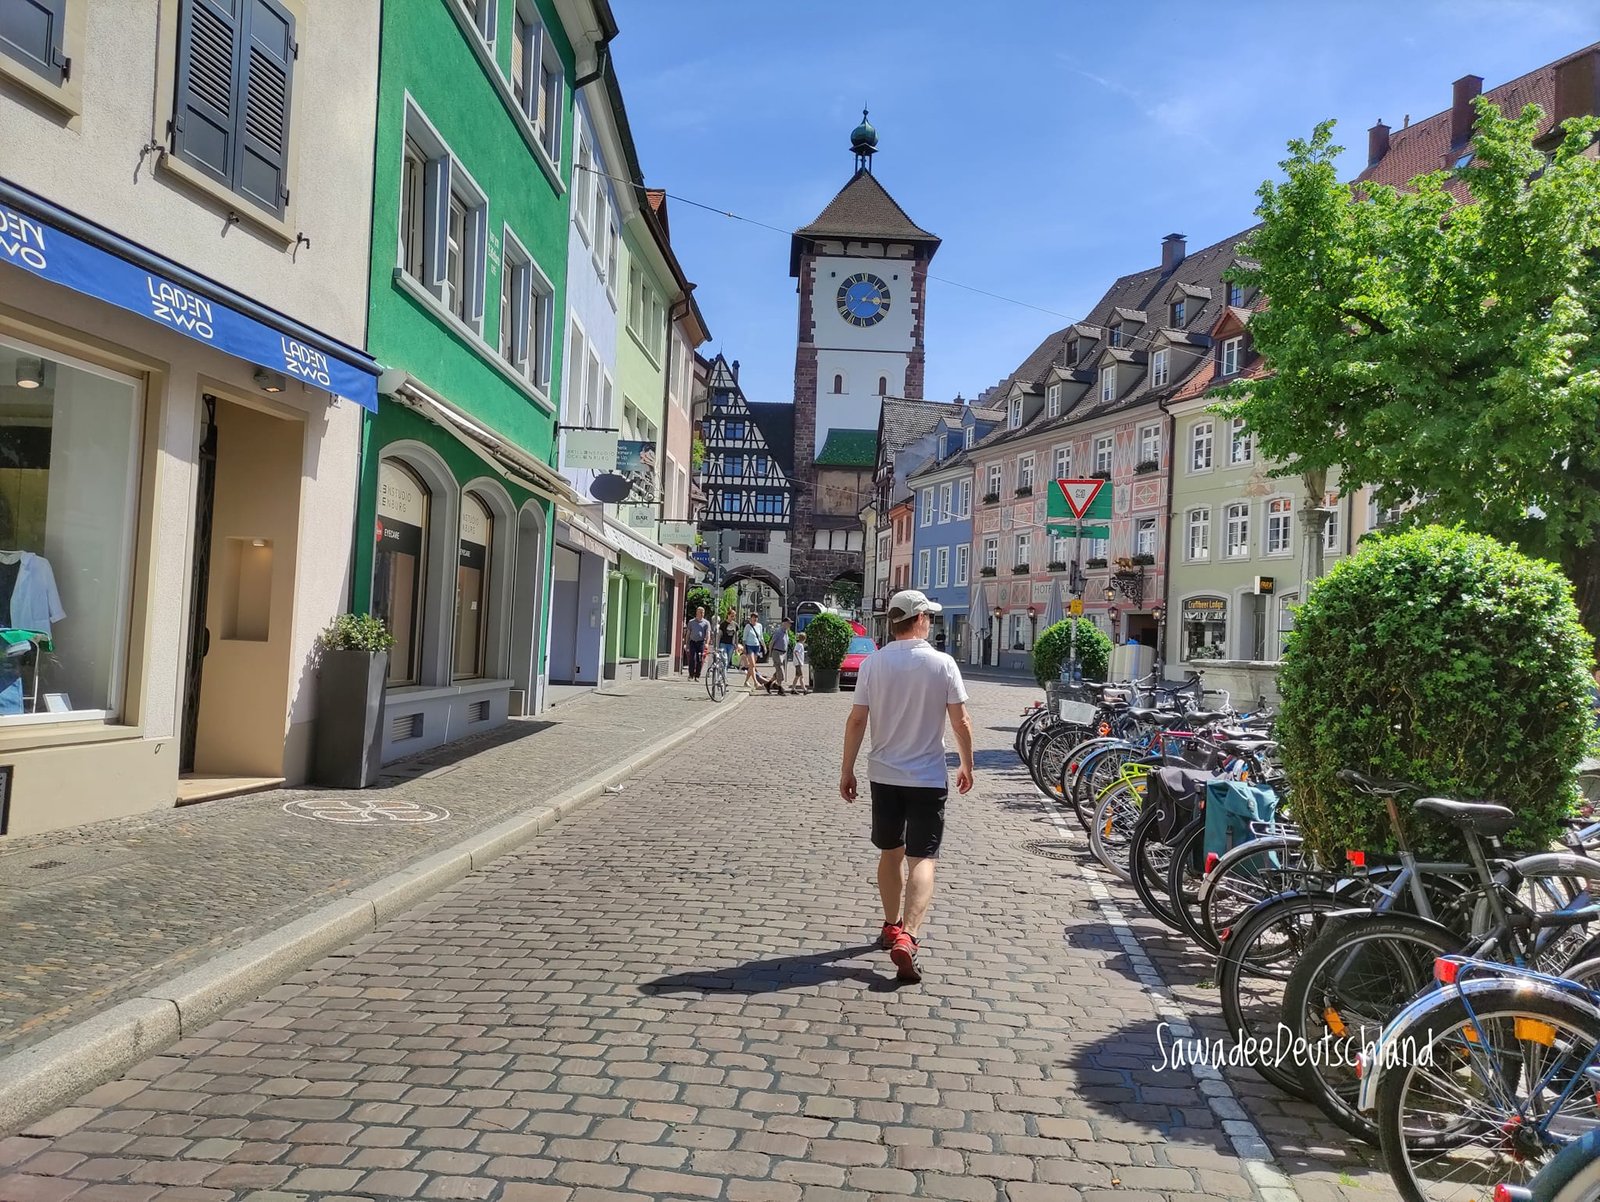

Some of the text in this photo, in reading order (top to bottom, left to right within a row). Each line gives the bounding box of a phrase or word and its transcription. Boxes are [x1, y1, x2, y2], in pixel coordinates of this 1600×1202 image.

[147, 277, 213, 323] LADEN
[152, 301, 213, 339] ZWO
[281, 337, 328, 372] LADEN
[285, 357, 330, 386] ZWO
[1034, 584, 1052, 594] HOTE
[1209, 600, 1224, 610] Lodge
